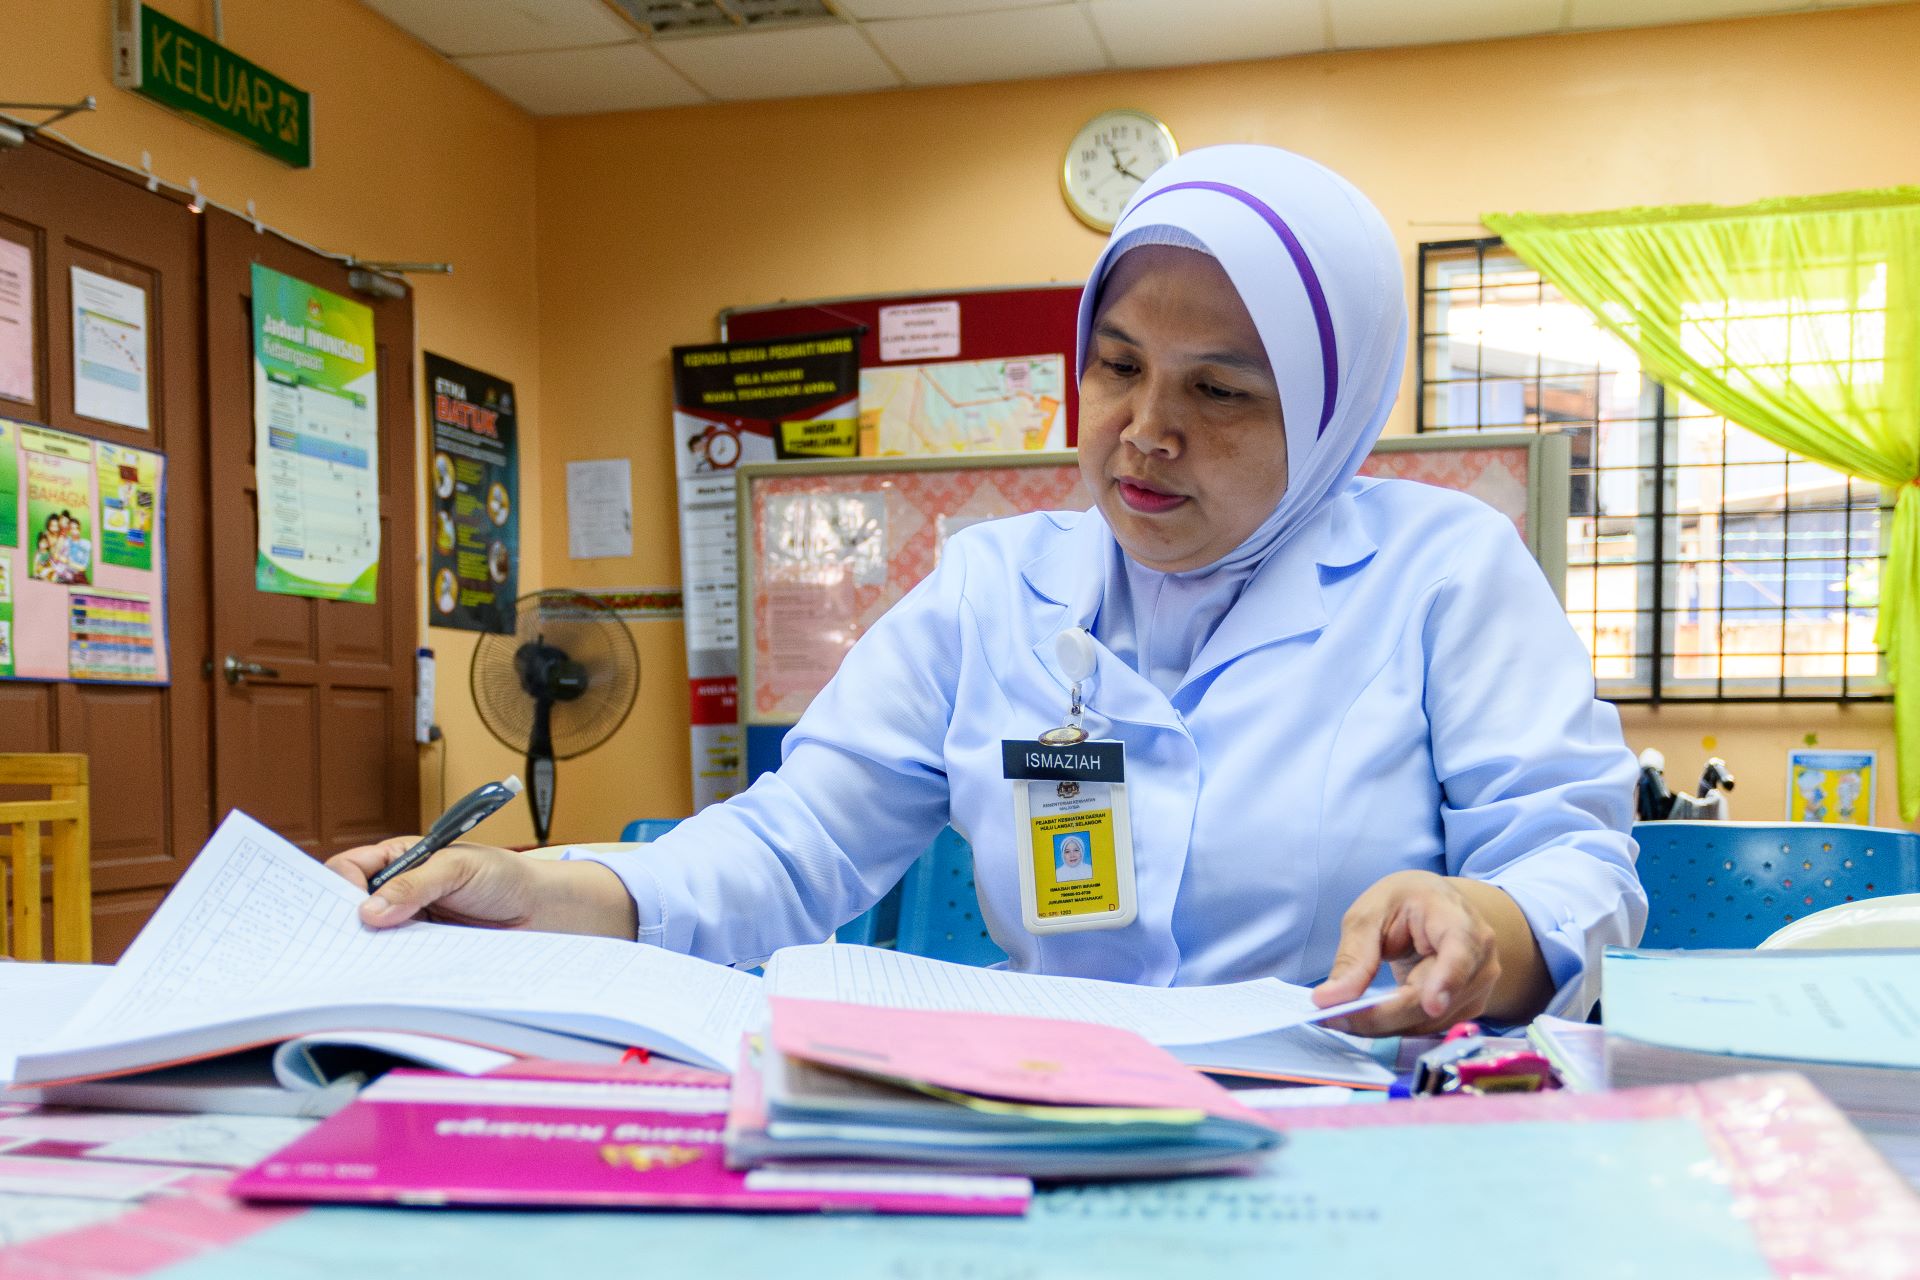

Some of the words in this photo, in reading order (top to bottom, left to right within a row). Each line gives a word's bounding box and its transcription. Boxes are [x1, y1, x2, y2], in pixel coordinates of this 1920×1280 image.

[152, 24, 273, 133] KELUAR
[263, 314, 304, 344] Jadual
[307, 328, 365, 364] IMUNISASI
[435, 394, 499, 439] BATUK
[1026, 752, 1101, 770] ISMAZIAH
[1035, 818, 1057, 826] PEJABAT
